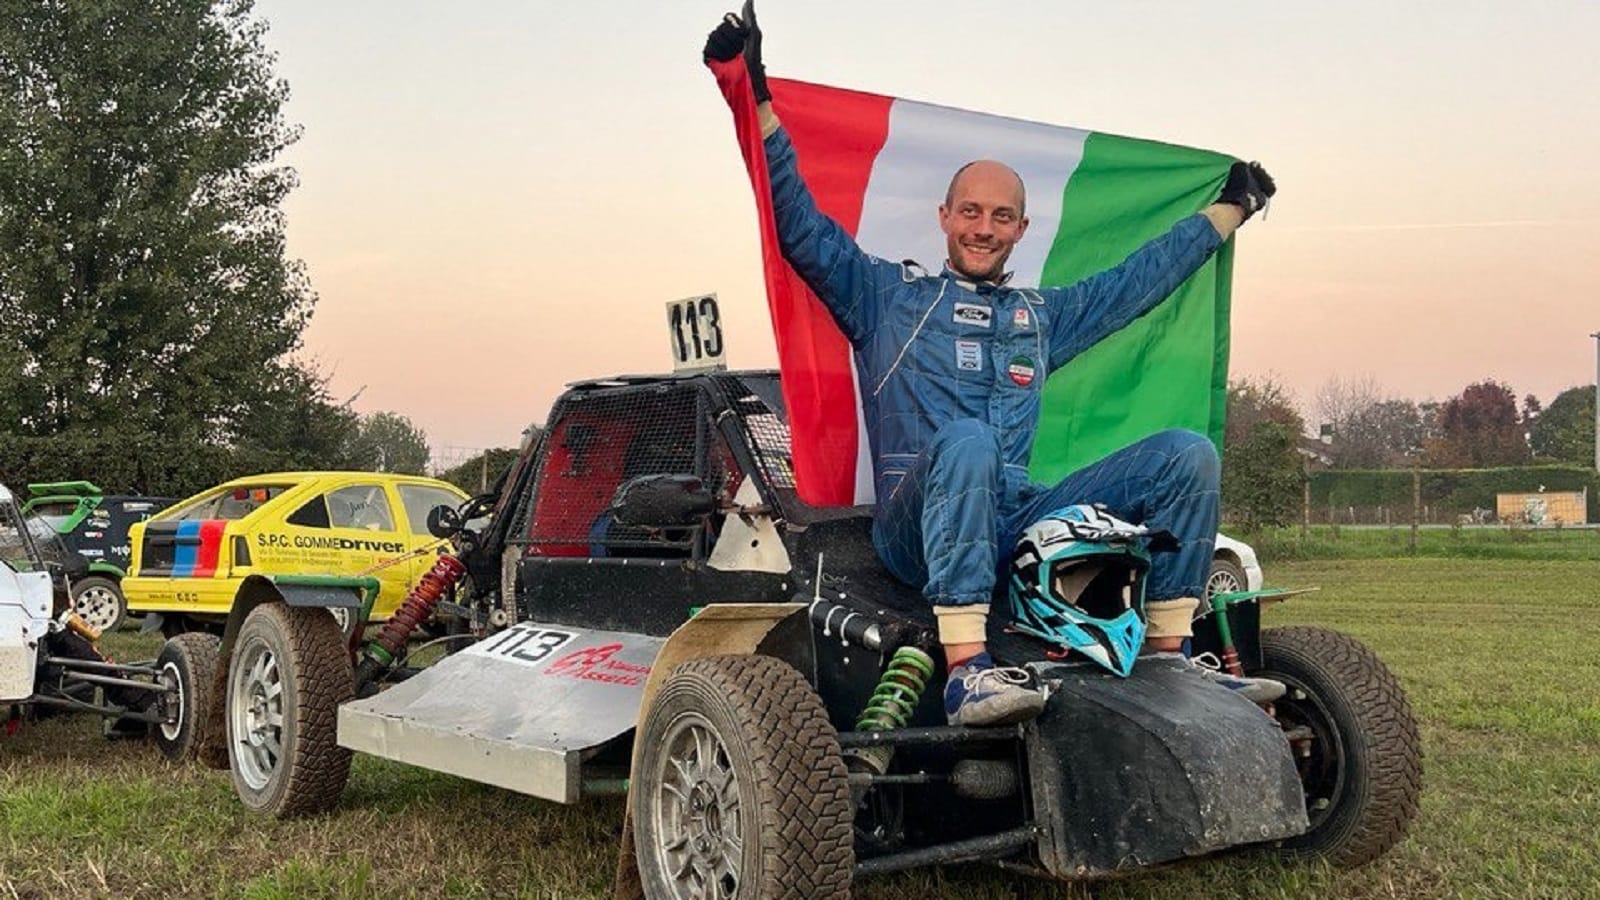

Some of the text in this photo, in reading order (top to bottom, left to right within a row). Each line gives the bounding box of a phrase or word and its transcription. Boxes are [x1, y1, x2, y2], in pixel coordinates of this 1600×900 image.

[671, 297, 723, 362] 113
[257, 533, 292, 548] S.P.C.
[486, 627, 570, 661] 113
